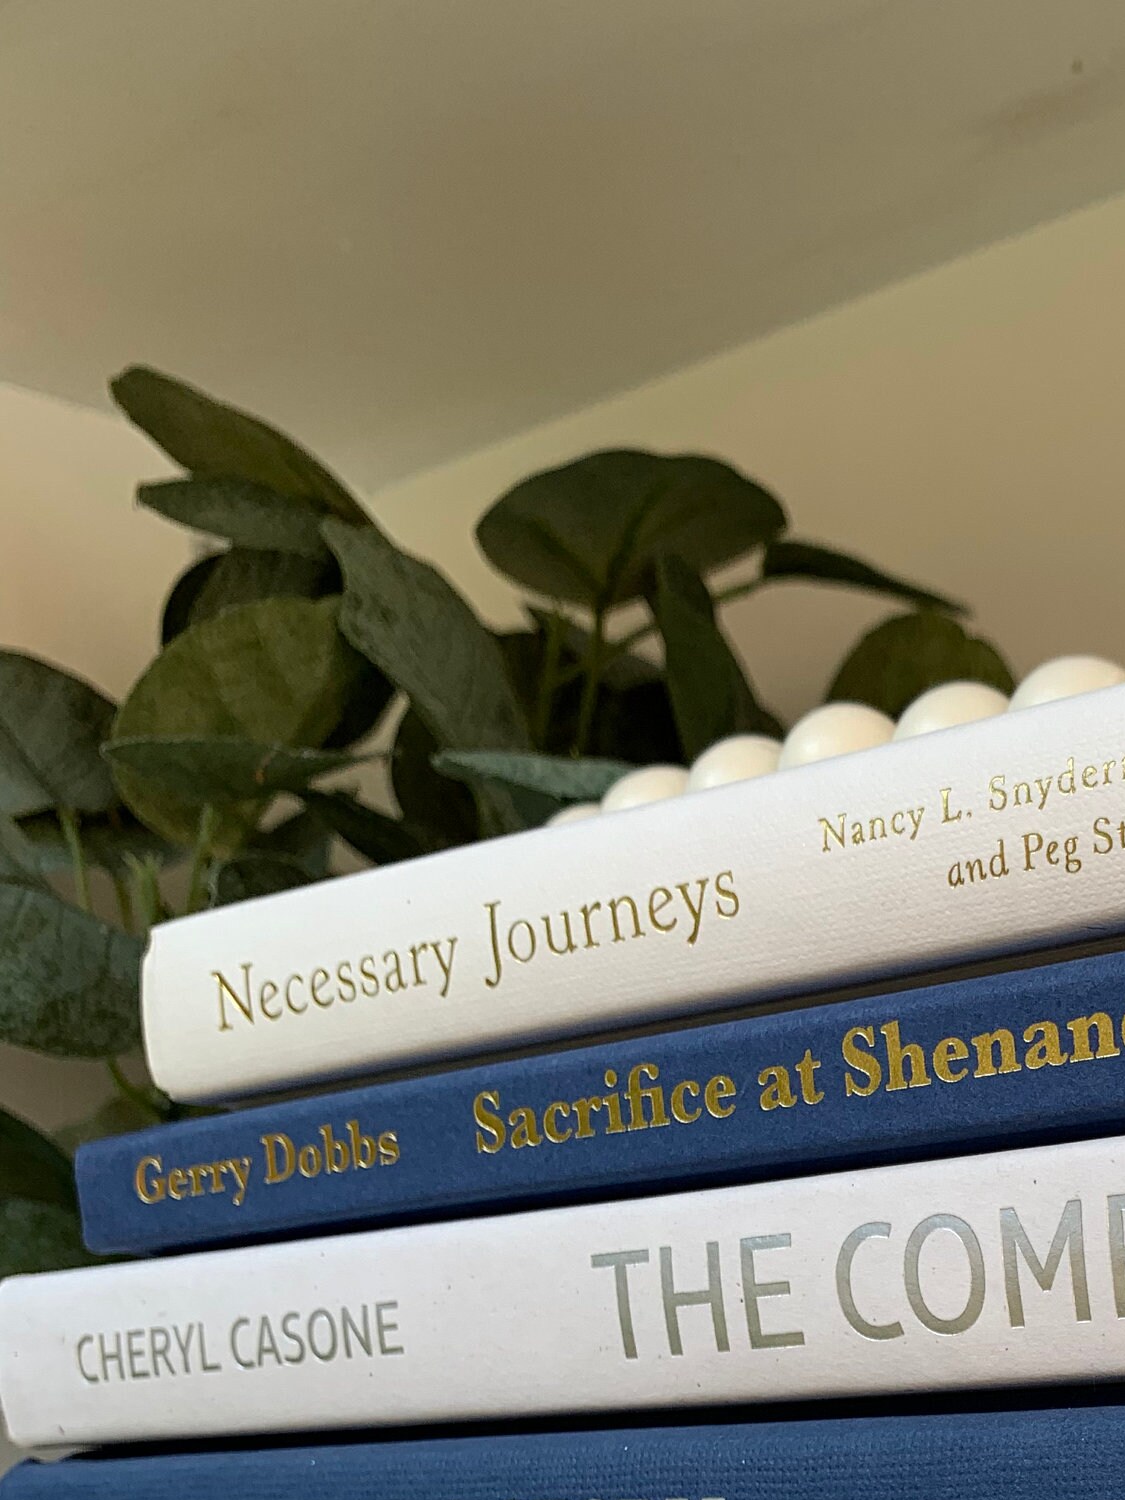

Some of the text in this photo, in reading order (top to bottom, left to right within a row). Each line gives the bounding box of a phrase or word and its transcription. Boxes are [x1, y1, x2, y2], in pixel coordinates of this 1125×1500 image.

[818, 803, 926, 853] Nancy
[938, 787, 973, 824] L.
[946, 839, 1009, 889] and
[1022, 833, 1083, 874] Peg
[211, 869, 741, 1031] Necessary Journeys
[472, 1063, 736, 1155] Sacrifice
[757, 1046, 824, 1112] at
[133, 1120, 401, 1207] Gerry Dobbs
[590, 1232, 806, 1360] THE
[75, 1300, 405, 1385] CHERYL CASONE
